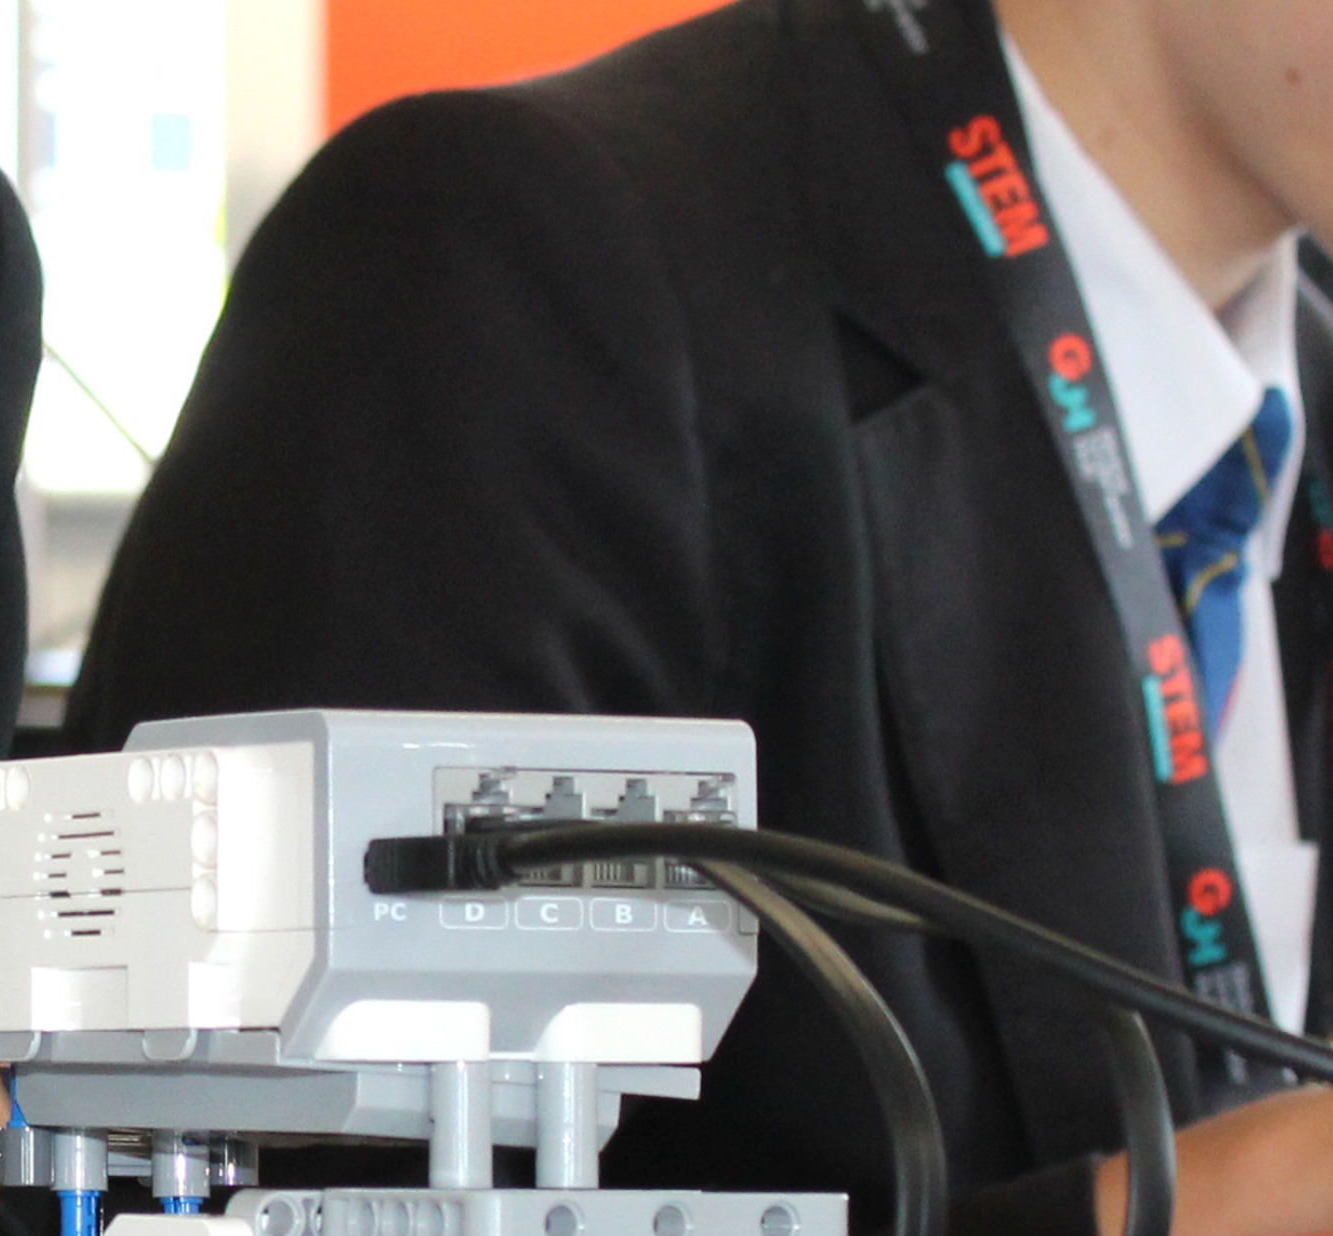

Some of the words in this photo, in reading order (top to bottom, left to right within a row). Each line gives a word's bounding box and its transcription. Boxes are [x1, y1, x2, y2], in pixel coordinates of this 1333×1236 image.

[948, 115, 1050, 258] STEM
[1148, 633, 1210, 785] STEM
[373, 903, 408, 922] PC
[466, 905, 485, 923] D
[540, 905, 559, 924] C
[615, 906, 633, 924] B
[686, 906, 708, 927] A
